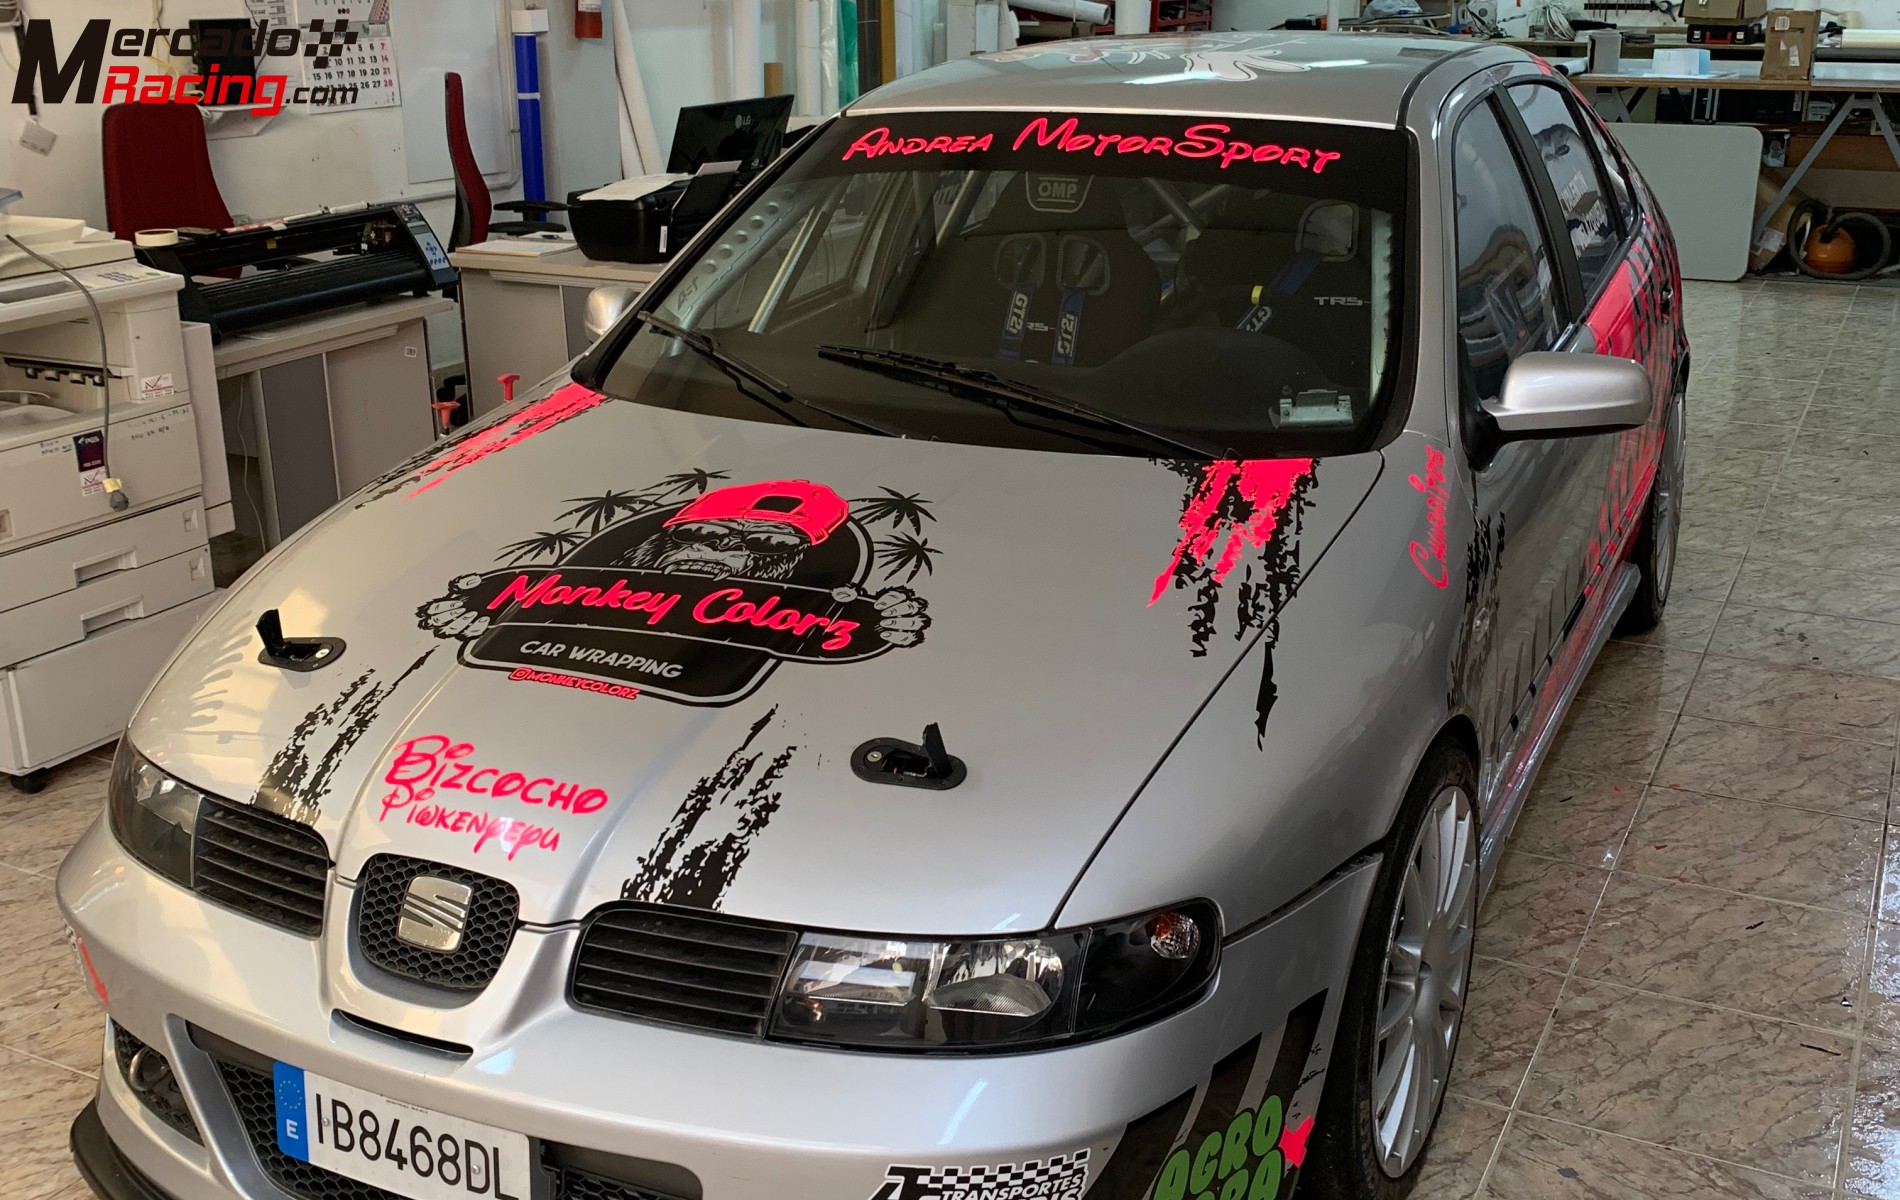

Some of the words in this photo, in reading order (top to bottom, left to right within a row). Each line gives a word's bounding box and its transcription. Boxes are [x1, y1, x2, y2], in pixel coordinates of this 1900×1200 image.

[334, 58, 343, 66] 10
[346, 57, 354, 65] 11
[358, 56, 366, 64] 12
[369, 55, 378, 63] 13
[381, 54, 389, 62] 14
[312, 73, 321, 81] 15
[324, 72, 333, 80] 16
[336, 71, 344, 79] 17
[347, 70, 356, 78] 18
[359, 69, 367, 77] 19
[370, 68, 380, 76] 20
[382, 67, 391, 75] 21
[383, 79, 393, 87] 28
[1037, 181, 1078, 199] OMP
[487, 573, 681, 625] Monkey
[692, 588, 861, 651] Colorz
[520, 640, 566, 658] CAR
[568, 645, 685, 679] WRAPPING
[285, 1118, 299, 1140] E
[315, 1093, 519, 1200] IB8468DL
[1153, 1095, 1283, 1200] AGRO
[941, 1173, 1083, 1200] TRANSPORTES
